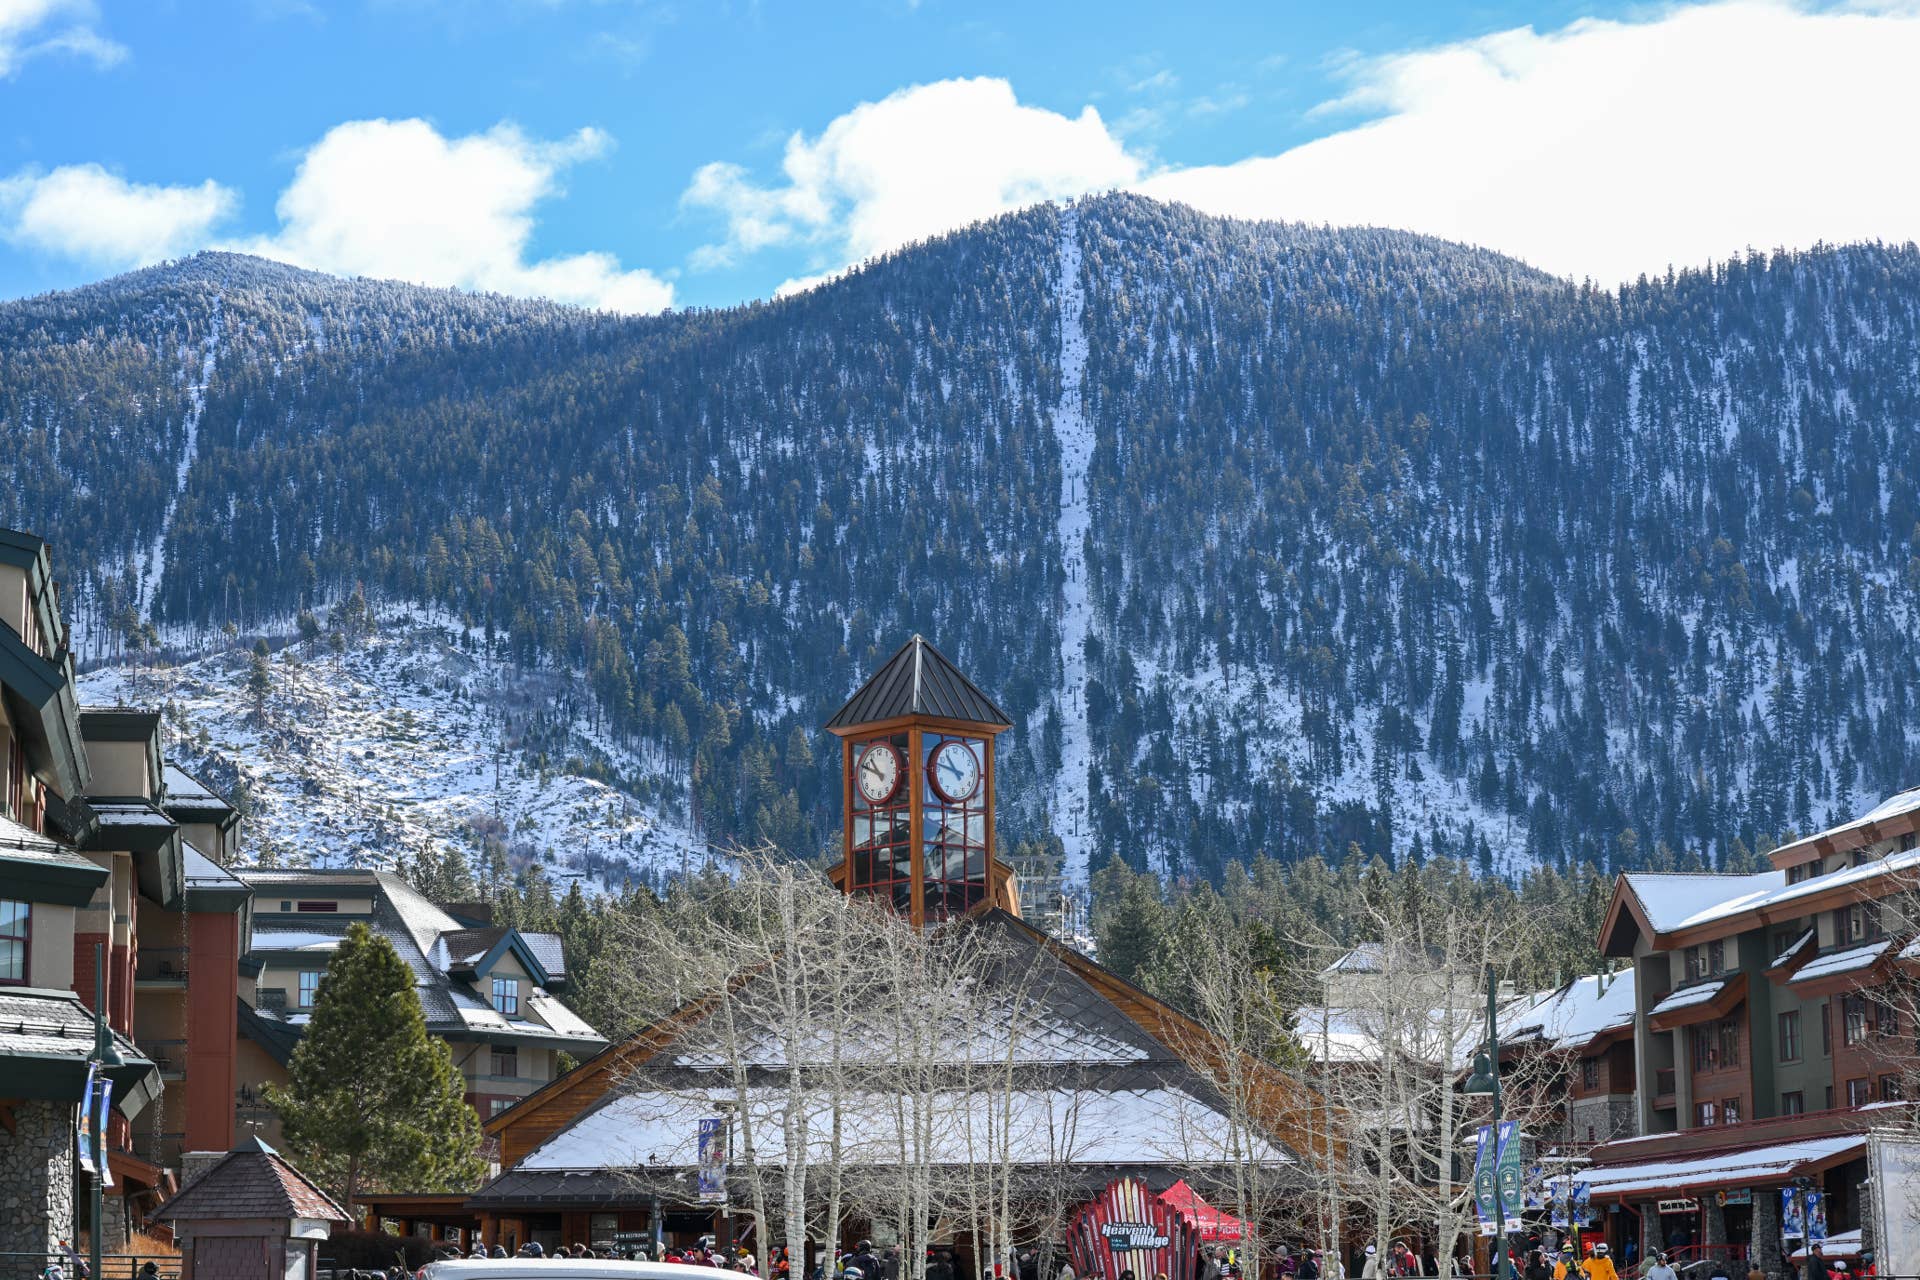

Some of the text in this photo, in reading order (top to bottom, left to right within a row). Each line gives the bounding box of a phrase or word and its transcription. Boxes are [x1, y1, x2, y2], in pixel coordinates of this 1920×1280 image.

[876, 749, 882, 757] 12
[1102, 1224, 1157, 1237] Heavenly
[1130, 1234, 1169, 1248] Village
